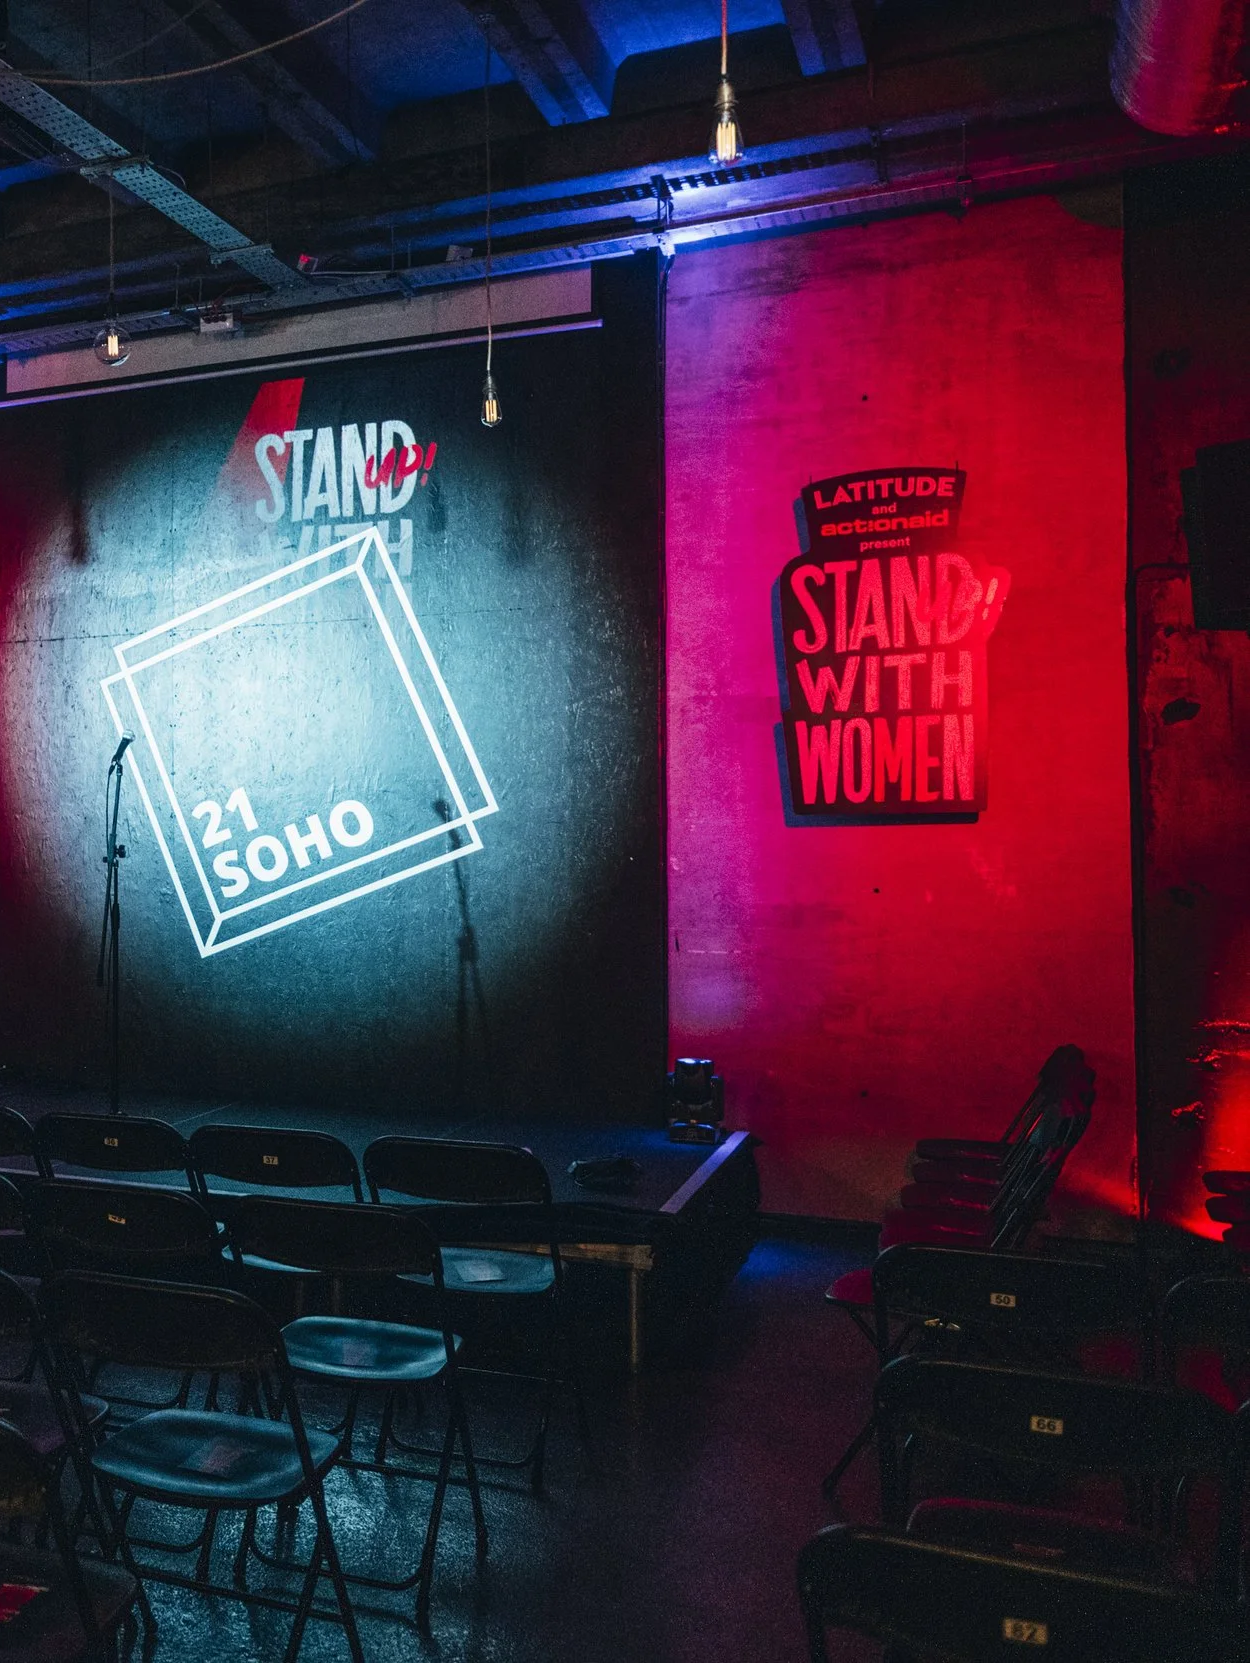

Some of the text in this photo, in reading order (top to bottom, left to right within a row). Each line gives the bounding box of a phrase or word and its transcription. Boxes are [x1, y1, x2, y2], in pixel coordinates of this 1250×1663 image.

[254, 418, 439, 523] STAND UP!
[813, 476, 956, 510] LATITUDE
[871, 502, 897, 515] and
[859, 536, 911, 552] present
[790, 552, 976, 655] STAND
[794, 650, 974, 714] WITH
[794, 713, 976, 806] WOMEN
[190, 786, 261, 849] 21
[212, 799, 376, 898] SOHO
[994, 1294, 1012, 1306] 50
[1036, 1417, 1057, 1433] 66
